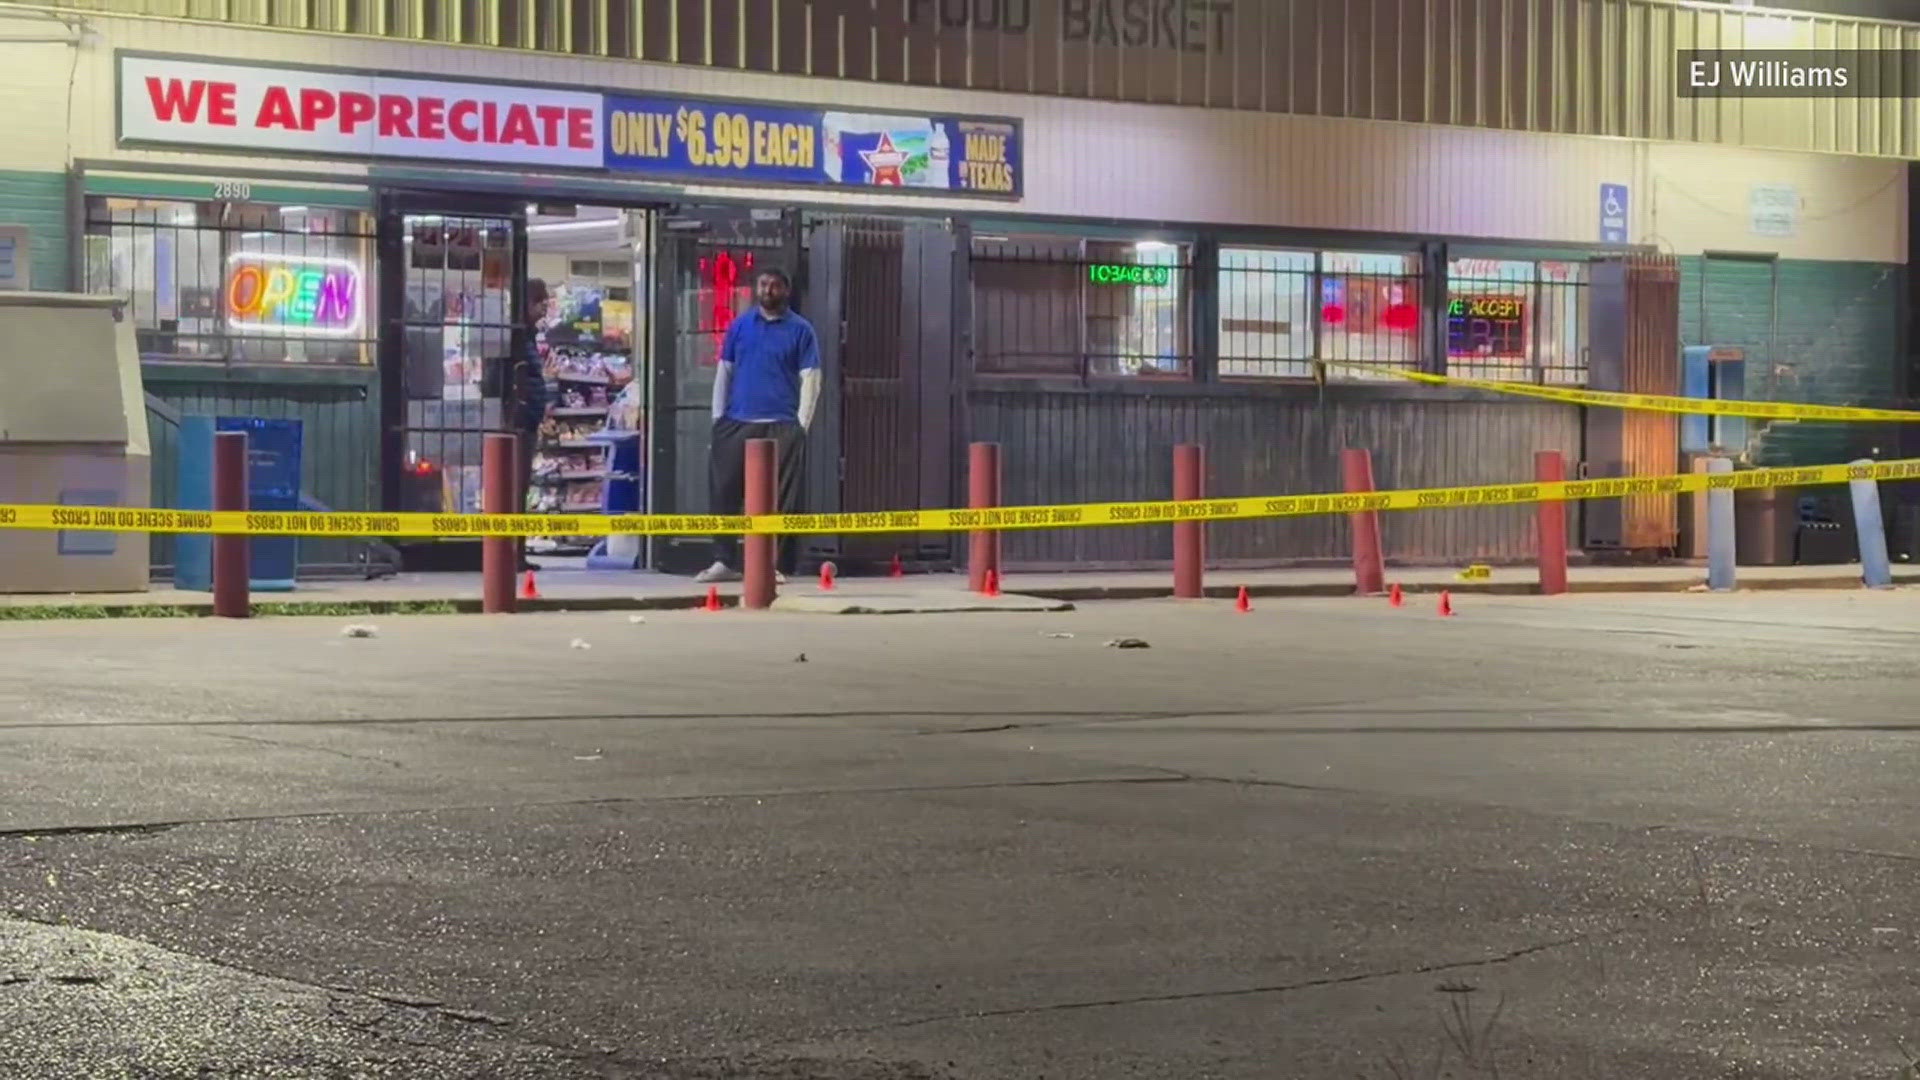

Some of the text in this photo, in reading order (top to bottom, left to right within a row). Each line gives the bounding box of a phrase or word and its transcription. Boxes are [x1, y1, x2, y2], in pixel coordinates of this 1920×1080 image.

[1063, 0, 1234, 54] BASKET
[145, 77, 595, 149] WE APPRECIATE
[611, 105, 815, 169] ONLY $6.99 EACH
[965, 133, 1007, 162] MADE
[967, 161, 1014, 192] TEXAS
[214, 182, 251, 199] 2890
[1089, 264, 1168, 283] TOBACCO
[230, 266, 356, 320] OPEN
[1469, 299, 1524, 317] ACCEPT
[52, 508, 212, 529] CRIME SCENE DO NOT CROSS
[246, 514, 399, 531] CRIME SCENE DO NOT CROSS
[433, 518, 579, 533] CRIME SCENE DO NOT CROSS
[611, 518, 752, 531] CRIME SCENE DO NOT CROSS
[783, 512, 919, 530] CRIME SCENE DO NOT CROSS
